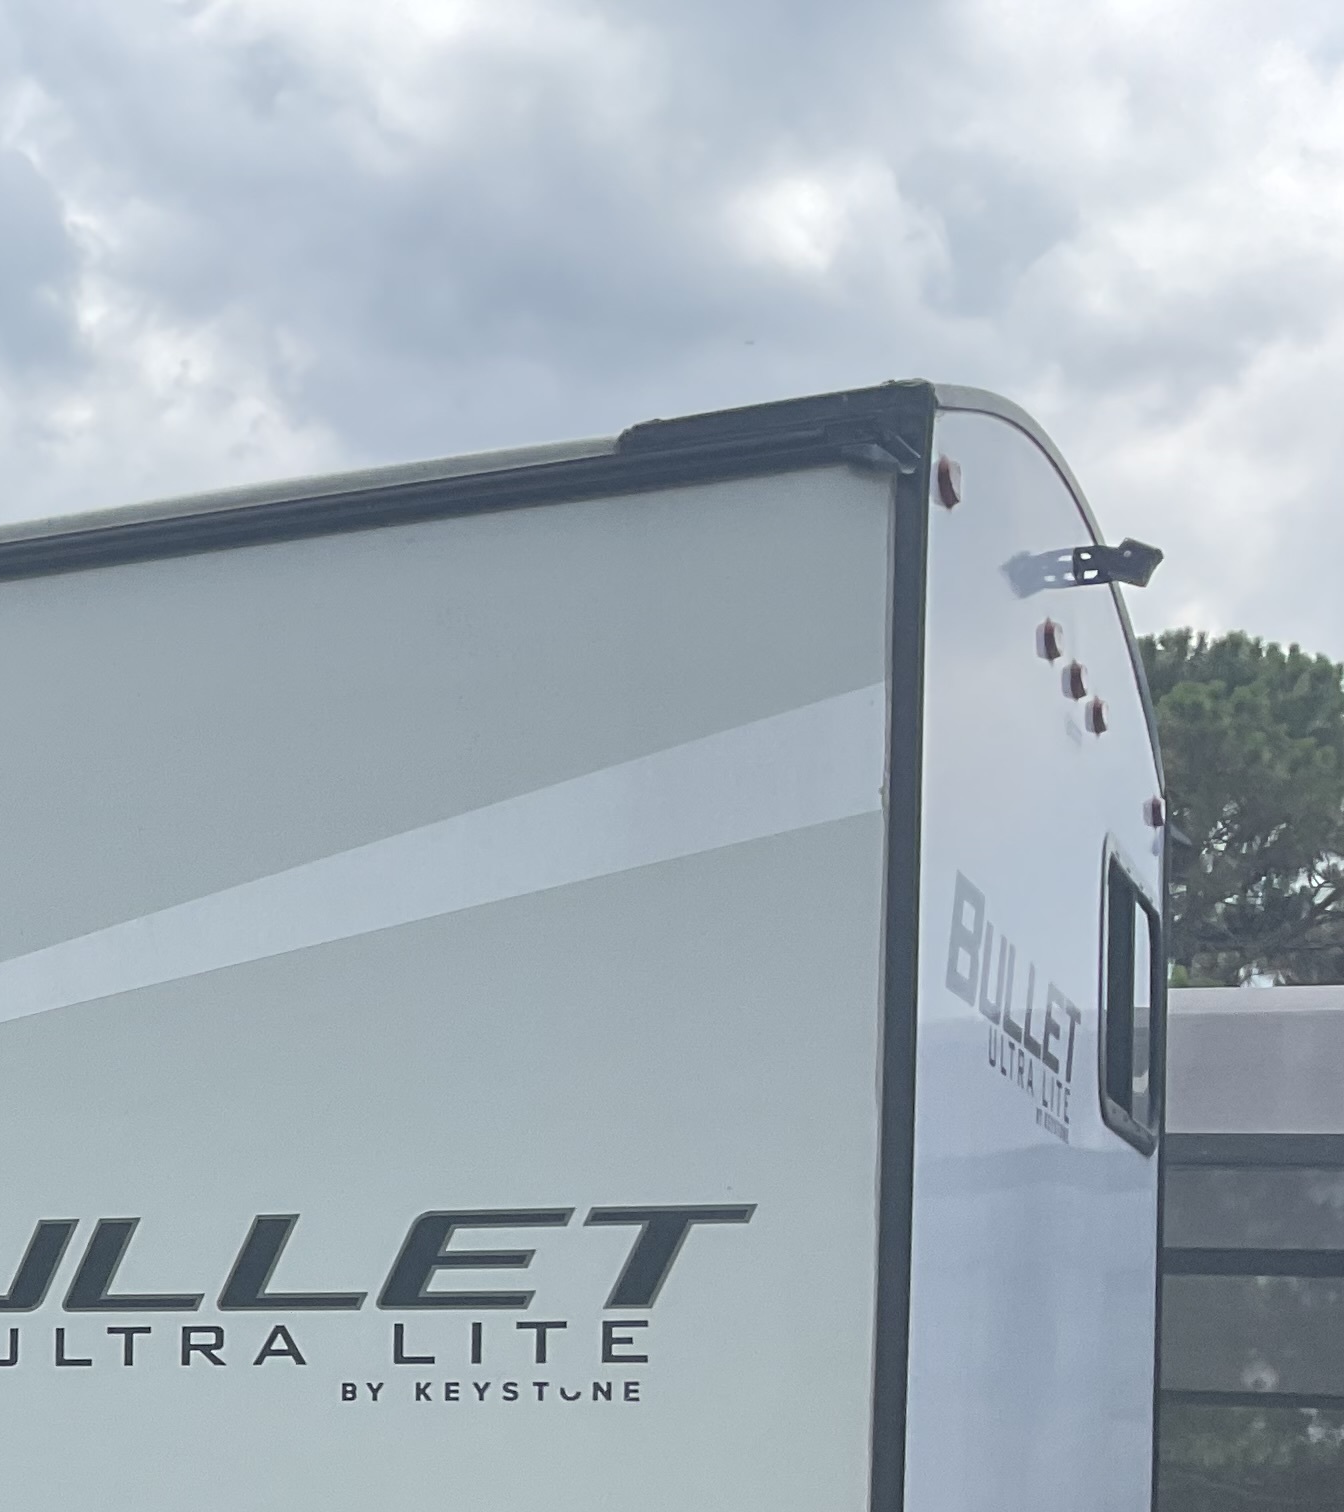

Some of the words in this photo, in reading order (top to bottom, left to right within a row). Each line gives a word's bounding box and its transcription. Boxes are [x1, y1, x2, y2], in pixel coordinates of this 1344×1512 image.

[945, 868, 1082, 1084] BULLET
[988, 1024, 1035, 1098] ULTRA
[1041, 1069, 1072, 1125] LITE
[392, 1319, 650, 1365] LITE
[340, 1381, 385, 1402] BY
[414, 1380, 641, 1402] KEYSTONE
